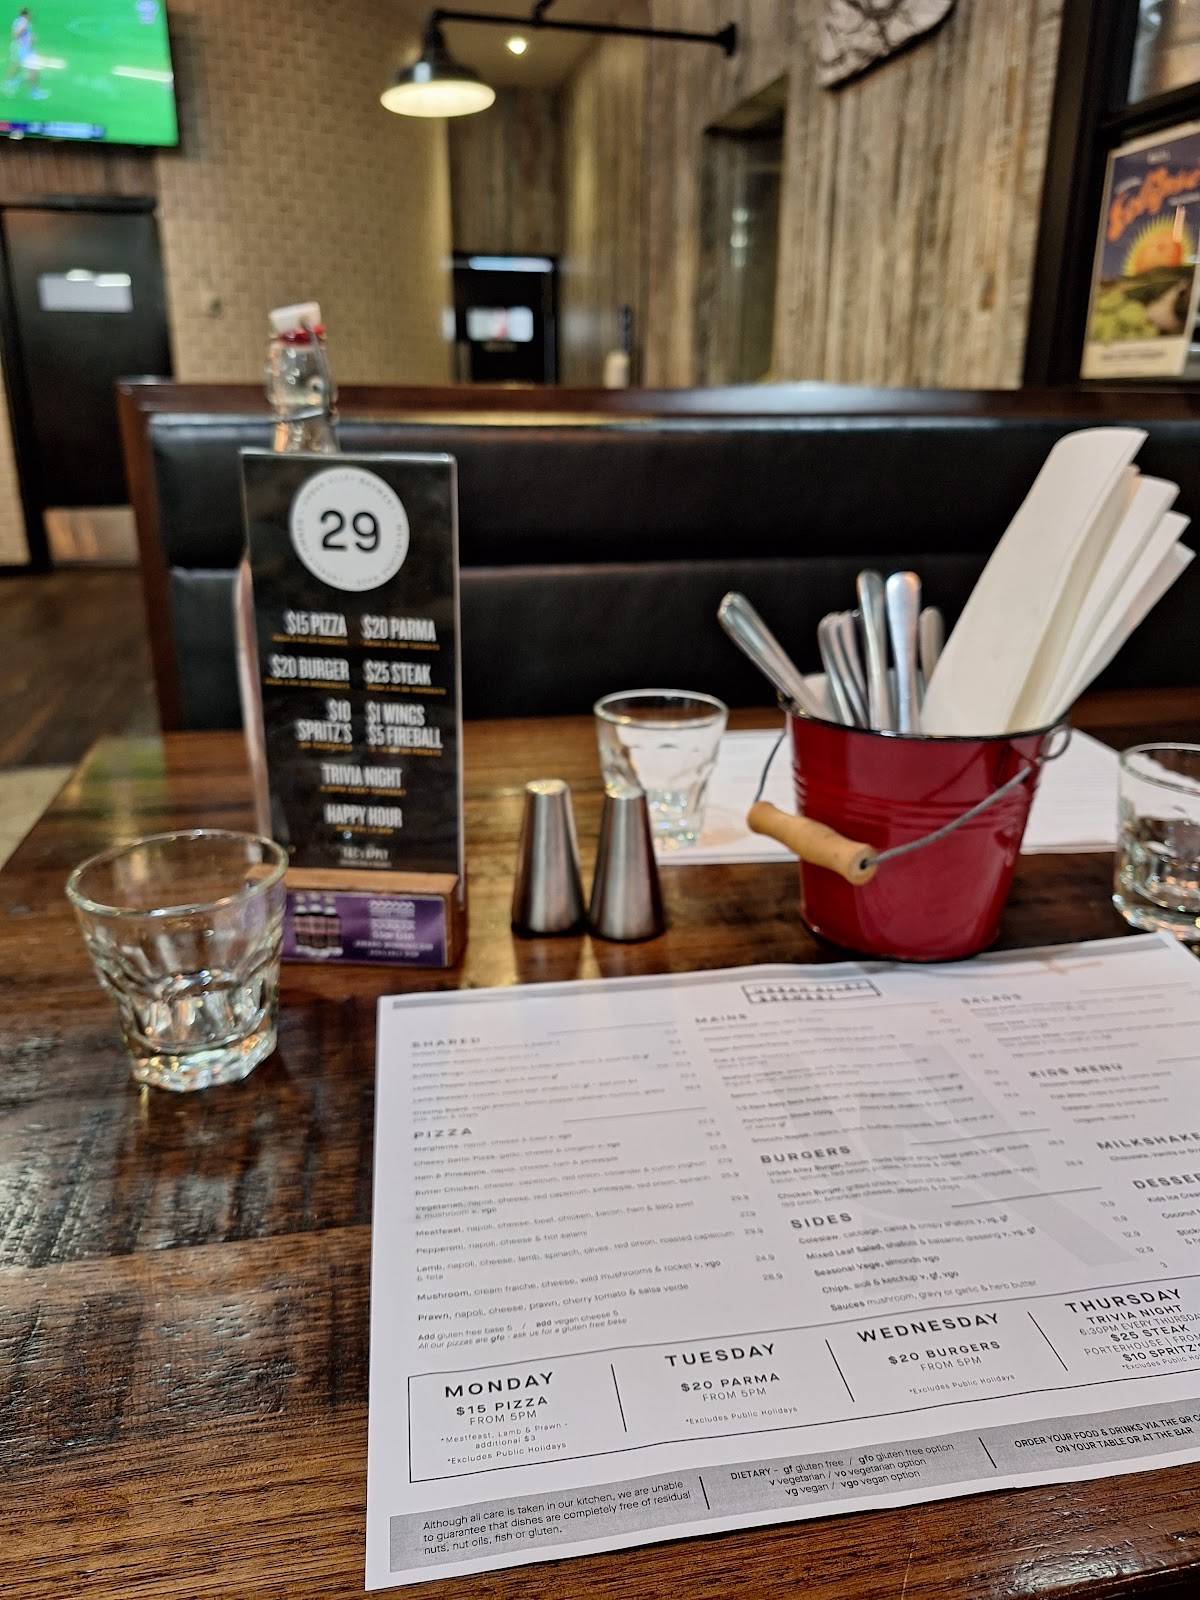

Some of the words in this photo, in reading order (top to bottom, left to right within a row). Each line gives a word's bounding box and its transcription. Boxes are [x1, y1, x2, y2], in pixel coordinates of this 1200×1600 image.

[320, 510, 380, 553] 29
[284, 610, 309, 635] $15
[310, 613, 348, 637] PIZZA
[361, 614, 388, 639] $20
[390, 617, 436, 642] PARMA
[270, 654, 297, 678] $20
[299, 656, 349, 681] BURGER
[363, 659, 389, 684] $25
[392, 662, 432, 685] STEAK
[328, 698, 351, 722] $10
[366, 701, 381, 724] $1
[384, 703, 425, 726] WINGS
[297, 719, 352, 744] SPRITZ'S
[367, 725, 384, 746] $5
[386, 726, 443, 748] FIREBALL
[321, 763, 364, 786] TRIVIA
[365, 766, 402, 788] NIGHT
[324, 804, 366, 825] HAPPY
[367, 806, 402, 828] HOUR
[411, 1036, 481, 1048] SHARED
[1029, 1067, 1069, 1077] KIDS
[1075, 1063, 1122, 1074] MENU
[414, 1128, 472, 1138] PIZZA
[761, 1146, 850, 1163] BURGERS
[791, 1213, 852, 1229] SIDES
[830, 1300, 865, 1311] Sauces
[1065, 1289, 1180, 1313] THURSDAY
[1086, 1312, 1136, 1324] TRIVIA
[1140, 1304, 1182, 1317] NIGHT
[857, 1313, 1000, 1342] WEDNESDAY
[1080, 1325, 1119, 1336] 6:30PM
[1121, 1320, 1152, 1330] EVERY
[1111, 1332, 1138, 1342] $25
[1142, 1324, 1190, 1337] STEAK
[665, 1343, 774, 1367] TUESDAY
[888, 1352, 920, 1365] $20
[927, 1341, 1001, 1358] BURGERS
[1084, 1339, 1164, 1356] PORTERHOUSE
[1123, 1352, 1147, 1362] $10
[920, 1361, 953, 1371] FROM
[957, 1356, 982, 1365] 5PM
[445, 1372, 553, 1397] MONDAY
[681, 1381, 713, 1392] $20
[721, 1373, 780, 1388] PARMA
[952, 1379, 978, 1388] Public
[980, 1374, 1015, 1384] Holidays
[456, 1405, 487, 1416] $15
[495, 1396, 548, 1411] PIZZA
[702, 1391, 737, 1402] FROM
[741, 1387, 767, 1397] 5PM
[469, 1415, 505, 1426] FROM
[510, 1410, 537, 1421] 5PM
[732, 1410, 758, 1419] Public
[762, 1406, 797, 1416] Holidays
[475, 1436, 521, 1449] additional
[524, 1434, 536, 1442] $3
[498, 1427, 522, 1437] Lamb
[534, 1422, 562, 1431] Prawn
[1015, 1436, 1047, 1448] ORDER
[1047, 1433, 1073, 1443] YOUR
[1073, 1430, 1099, 1439] FOOD
[1101, 1428, 1108, 1436] &
[1108, 1423, 1143, 1435] DRINKS
[1141, 1421, 1160, 1429] VIA
[1159, 1418, 1179, 1427] THE
[1179, 1415, 1193, 1424] QR
[1055, 1445, 1070, 1453] ON
[1070, 1441, 1097, 1451] YOUR
[1096, 1437, 1126, 1448] TABLE
[1127, 1435, 1141, 1444] OR
[1142, 1433, 1154, 1442] AT
[1154, 1430, 1174, 1439] THE
[1173, 1427, 1194, 1436] BAR
[496, 1448, 525, 1457] Public
[528, 1441, 567, 1453] Holidays
[731, 1468, 771, 1480] DIETARY
[784, 1465, 792, 1474] gf
[796, 1462, 823, 1473] gluten
[825, 1459, 844, 1468] free
[859, 1454, 874, 1465] gfo
[876, 1449, 904, 1461] gluten
[926, 1443, 954, 1455] option
[777, 1472, 826, 1485] vegetarian
[848, 1462, 896, 1476] vegetarian
[898, 1458, 927, 1469] option
[785, 1488, 798, 1496] vg
[800, 1483, 829, 1493] vegan
[840, 1479, 859, 1488] vgo
[860, 1475, 889, 1485] vegan
[891, 1470, 921, 1482] option
[423, 1515, 467, 1530] Although
[470, 1513, 480, 1522] all
[483, 1510, 504, 1519] care
[518, 1502, 545, 1515] taken
[547, 1501, 555, 1510] in
[558, 1500, 574, 1509] our
[576, 1493, 615, 1506] kitchen,
[618, 1491, 632, 1499] we
[634, 1487, 649, 1496] are
[651, 1481, 683, 1493] unable
[424, 1534, 434, 1542] to
[437, 1525, 486, 1542] guarantee
[489, 1520, 508, 1531] that
[511, 1514, 543, 1527] dishes
[546, 1513, 561, 1522] are
[563, 1505, 617, 1520] completely
[620, 1501, 639, 1510] free
[641, 1497, 651, 1507] of
[654, 1491, 691, 1504] residual
[424, 1543, 449, 1555] nuts,
[453, 1541, 469, 1551] nut
[471, 1537, 492, 1547] oils,
[495, 1532, 513, 1543] fish
[515, 1530, 525, 1538] or
[528, 1526, 562, 1538] gluten.
